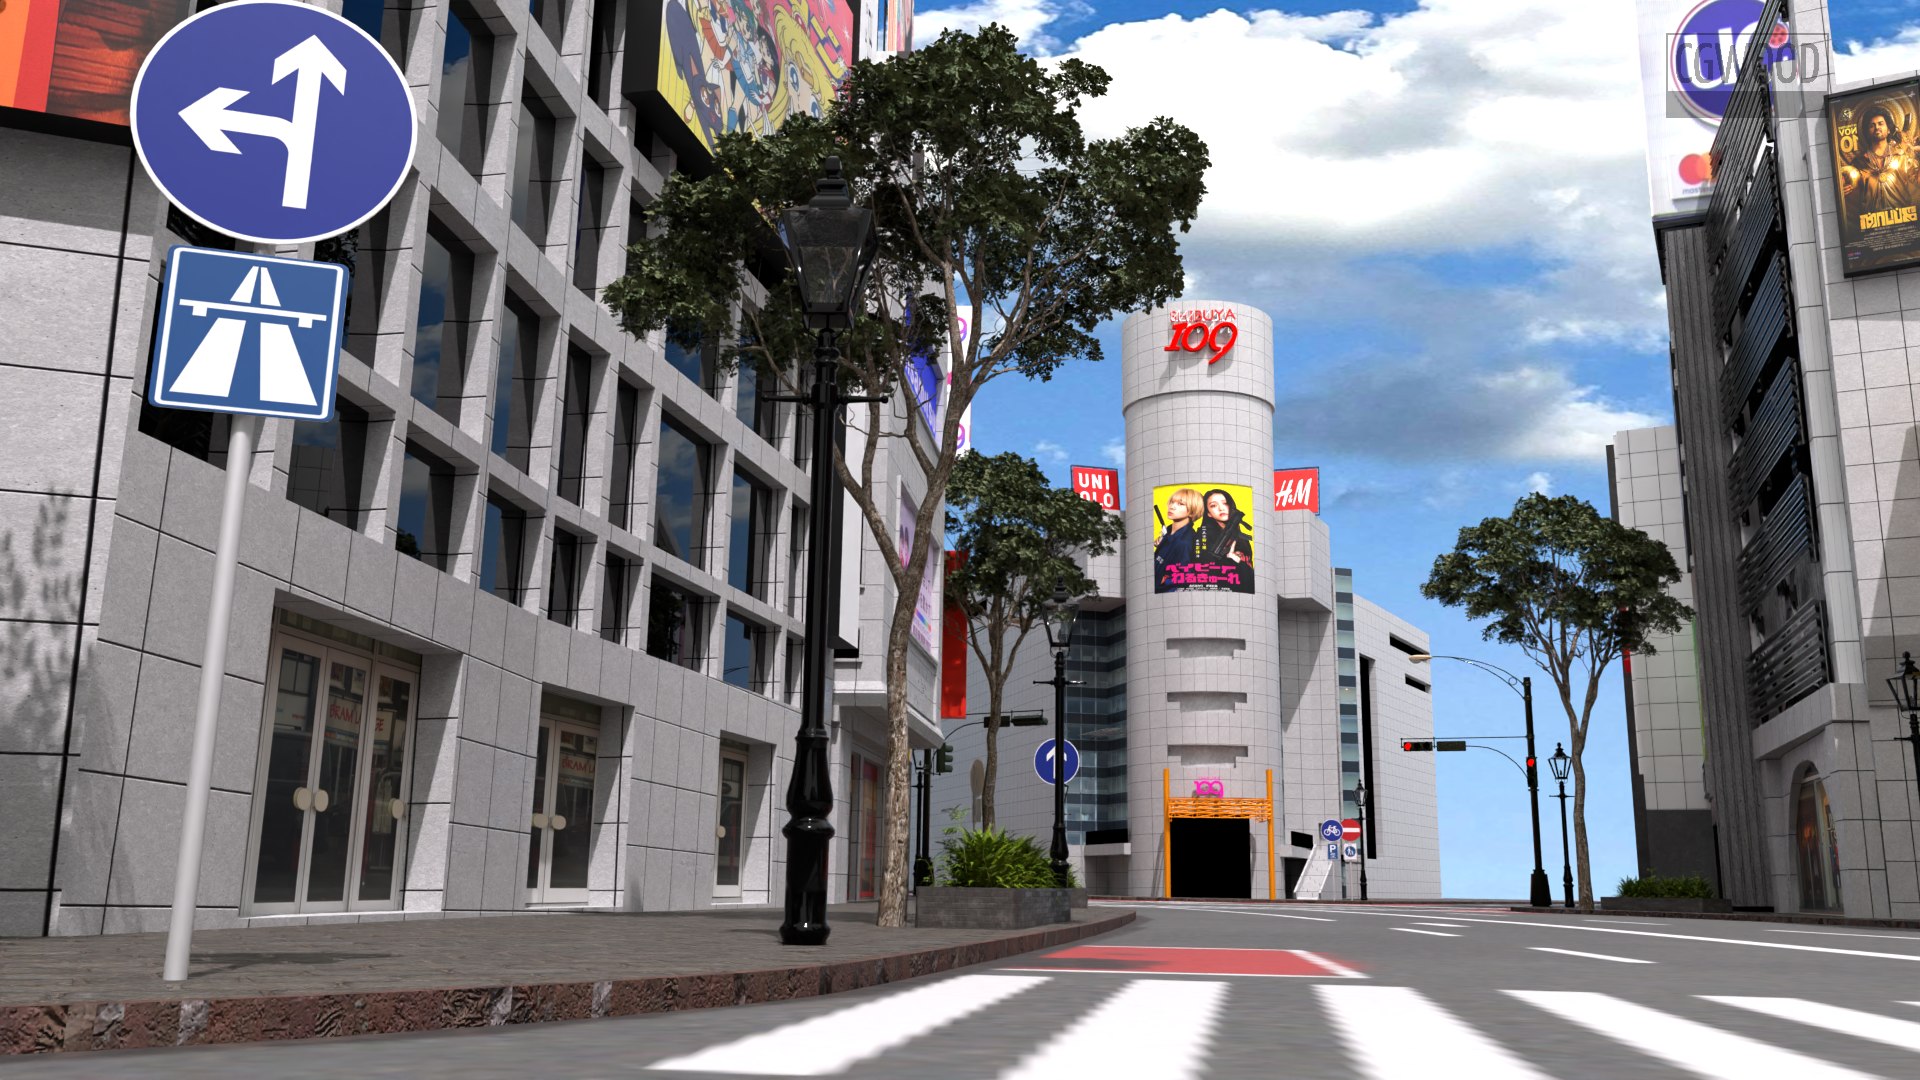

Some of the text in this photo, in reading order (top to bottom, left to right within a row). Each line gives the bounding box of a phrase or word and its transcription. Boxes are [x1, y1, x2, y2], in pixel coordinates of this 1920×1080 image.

[1164, 322, 1238, 365] 109
[1078, 472, 1110, 490] UNI
[1275, 477, 1312, 507] H&M
[1193, 781, 1224, 799] 109
[1329, 844, 1337, 853] P
